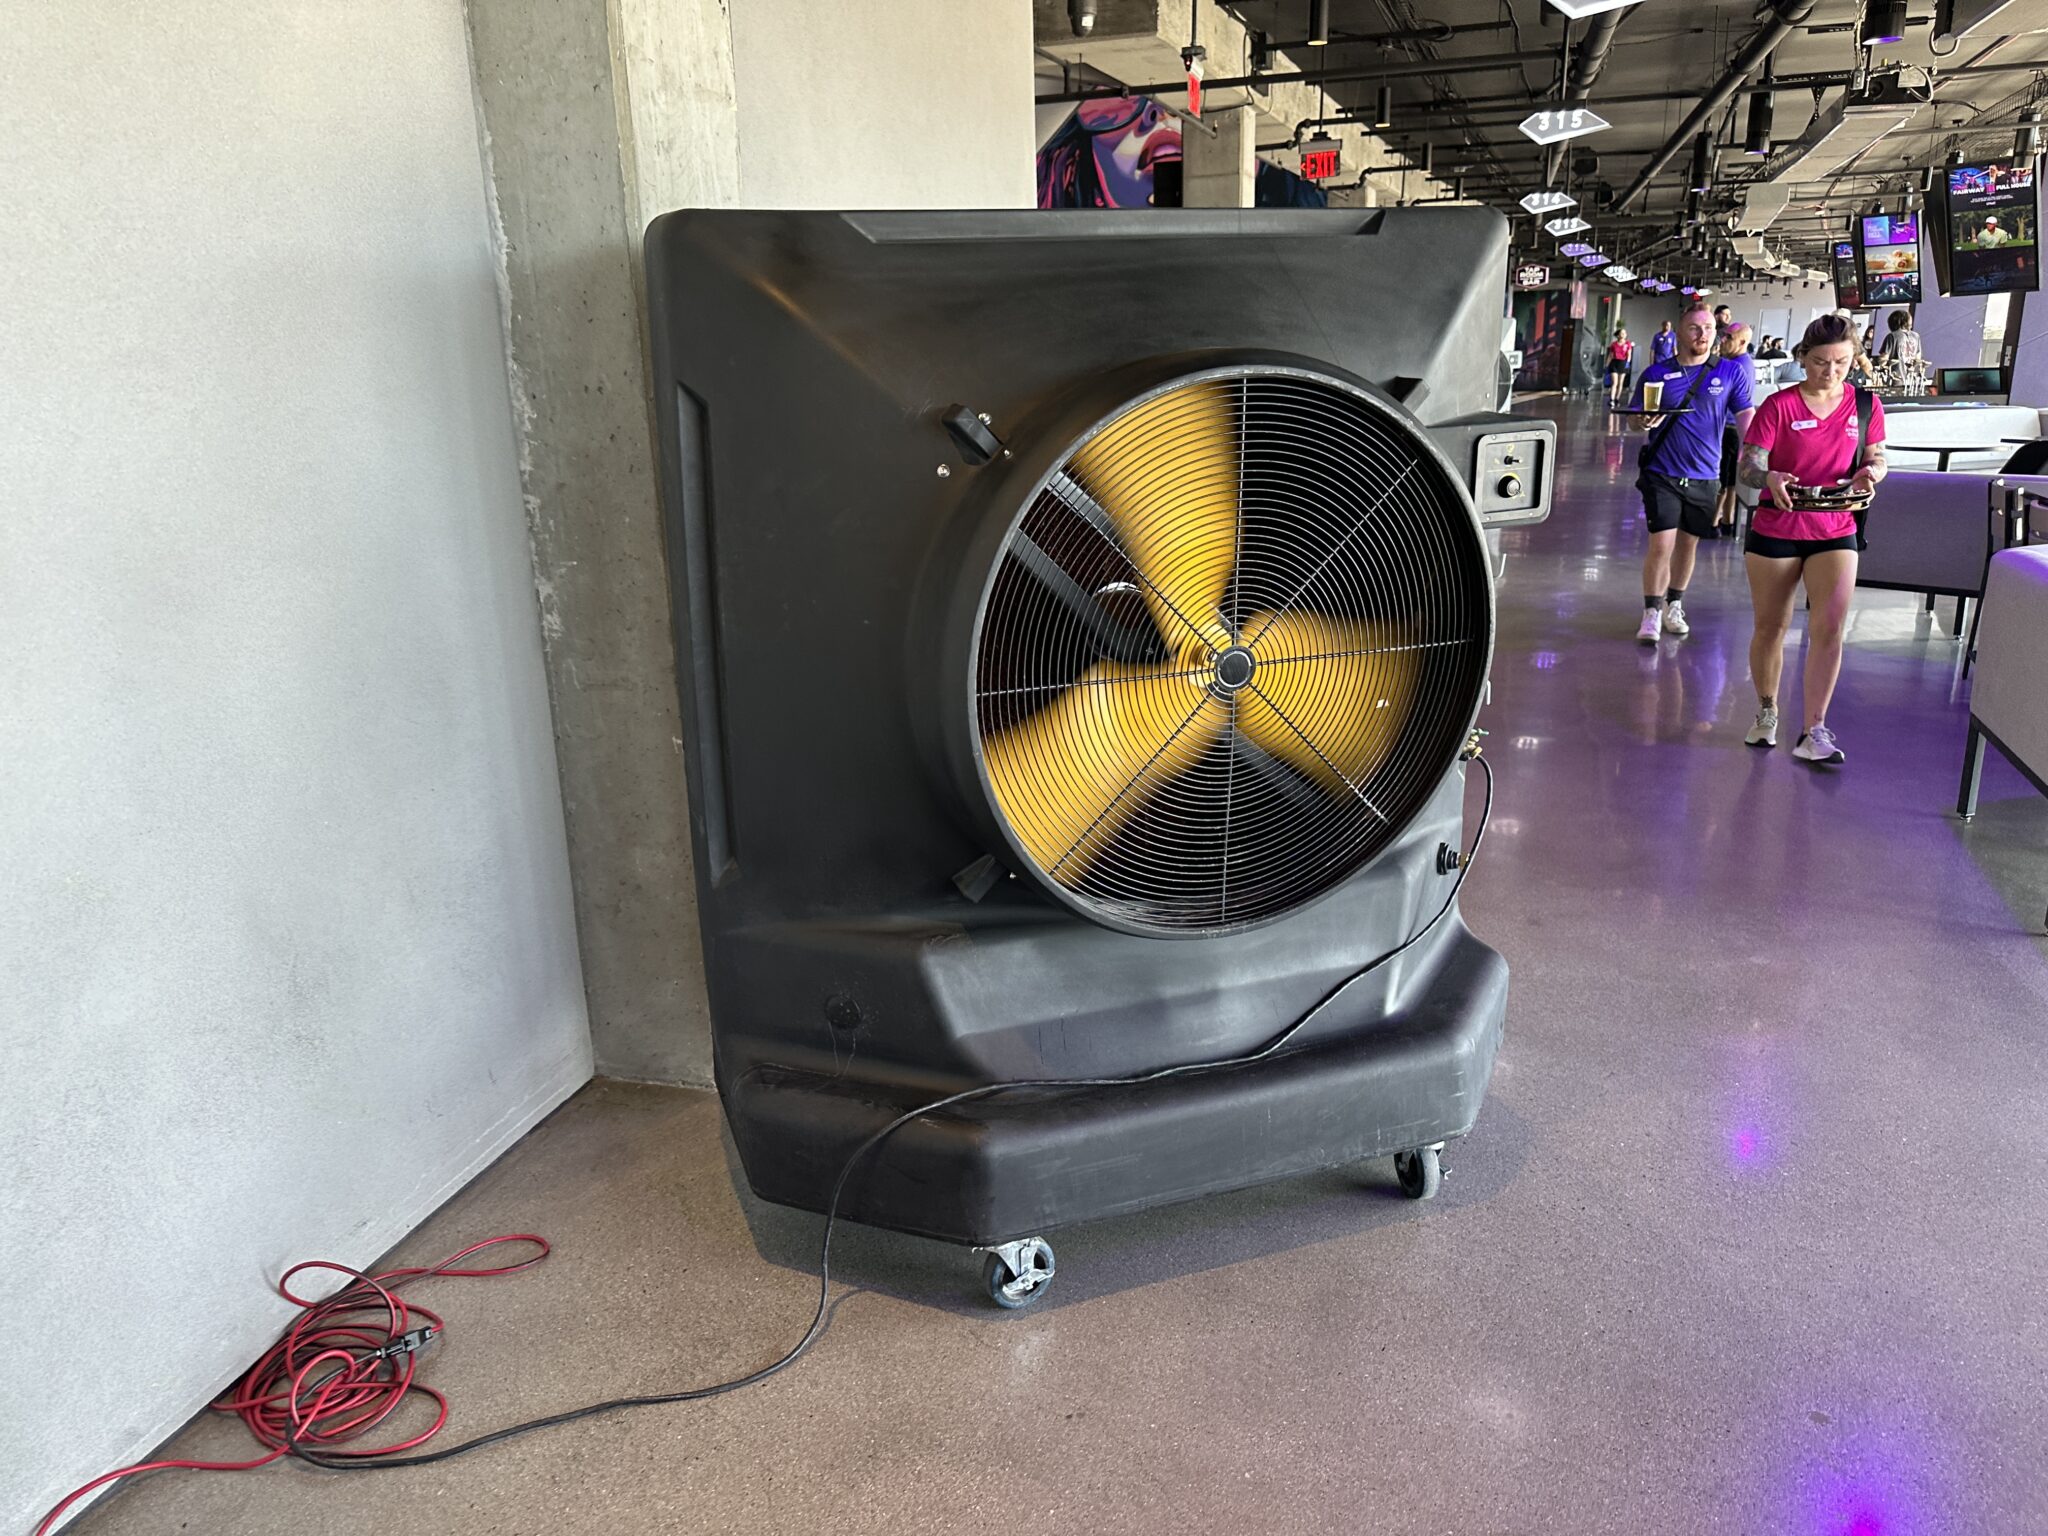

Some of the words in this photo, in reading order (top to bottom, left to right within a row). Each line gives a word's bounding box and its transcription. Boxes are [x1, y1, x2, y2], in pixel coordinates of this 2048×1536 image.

[1538, 109, 1583, 131] 315
[1306, 151, 1336, 178] EXIT
[1953, 187, 1985, 195] FAIRWAY
[1531, 192, 1560, 206] 314
[1554, 218, 1579, 229] 313
